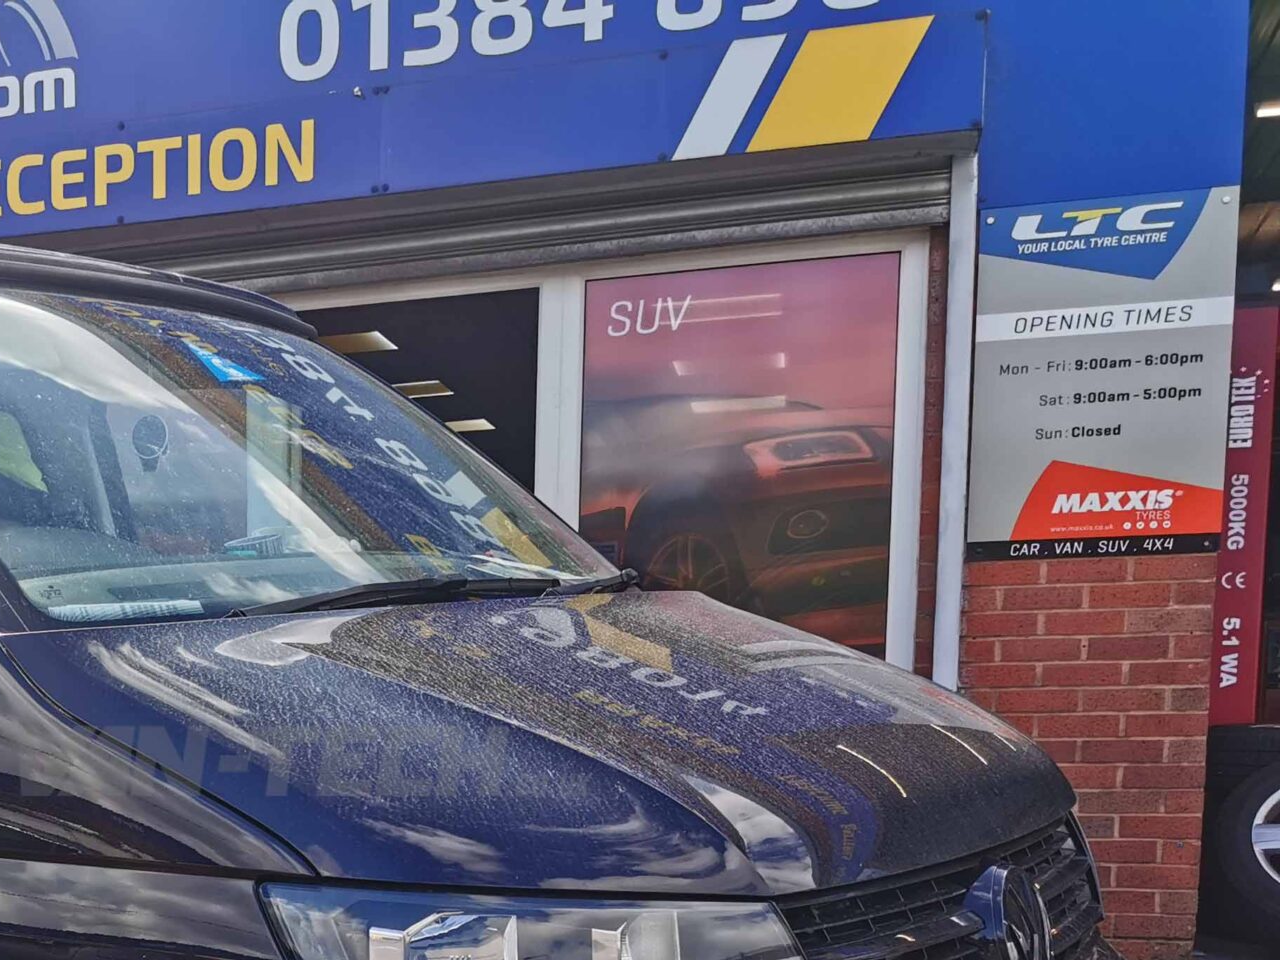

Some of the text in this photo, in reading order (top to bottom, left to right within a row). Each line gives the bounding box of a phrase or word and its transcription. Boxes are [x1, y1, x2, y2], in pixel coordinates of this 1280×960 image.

[278, 0, 615, 82] 01384
[1011, 201, 1184, 240] LTC
[1017, 231, 1168, 254] YOUR LOCAL TYRE CENTRE
[606, 295, 692, 337] SUV
[1013, 304, 1193, 334] OPENING TIMES
[999, 363, 1029, 376] Mon
[1046, 360, 1072, 373] Fri:
[1074, 357, 1132, 371] 9:00am
[1144, 352, 1203, 368] 6:00pm
[1073, 391, 1130, 405] 9:00am
[1143, 387, 1202, 401] 5:00pm
[1035, 424, 1122, 440] Sun: Closed
[1051, 488, 1174, 514] MAXXIS
[1227, 474, 1249, 551] 5000KG
[1135, 510, 1171, 520] TYRES
[1050, 523, 1114, 533] www.maxxis.co.uk
[1010, 543, 1040, 556] CAR
[1054, 541, 1084, 554] VAN
[1098, 539, 1130, 552] SUV
[1143, 537, 1174, 551] 4X4
